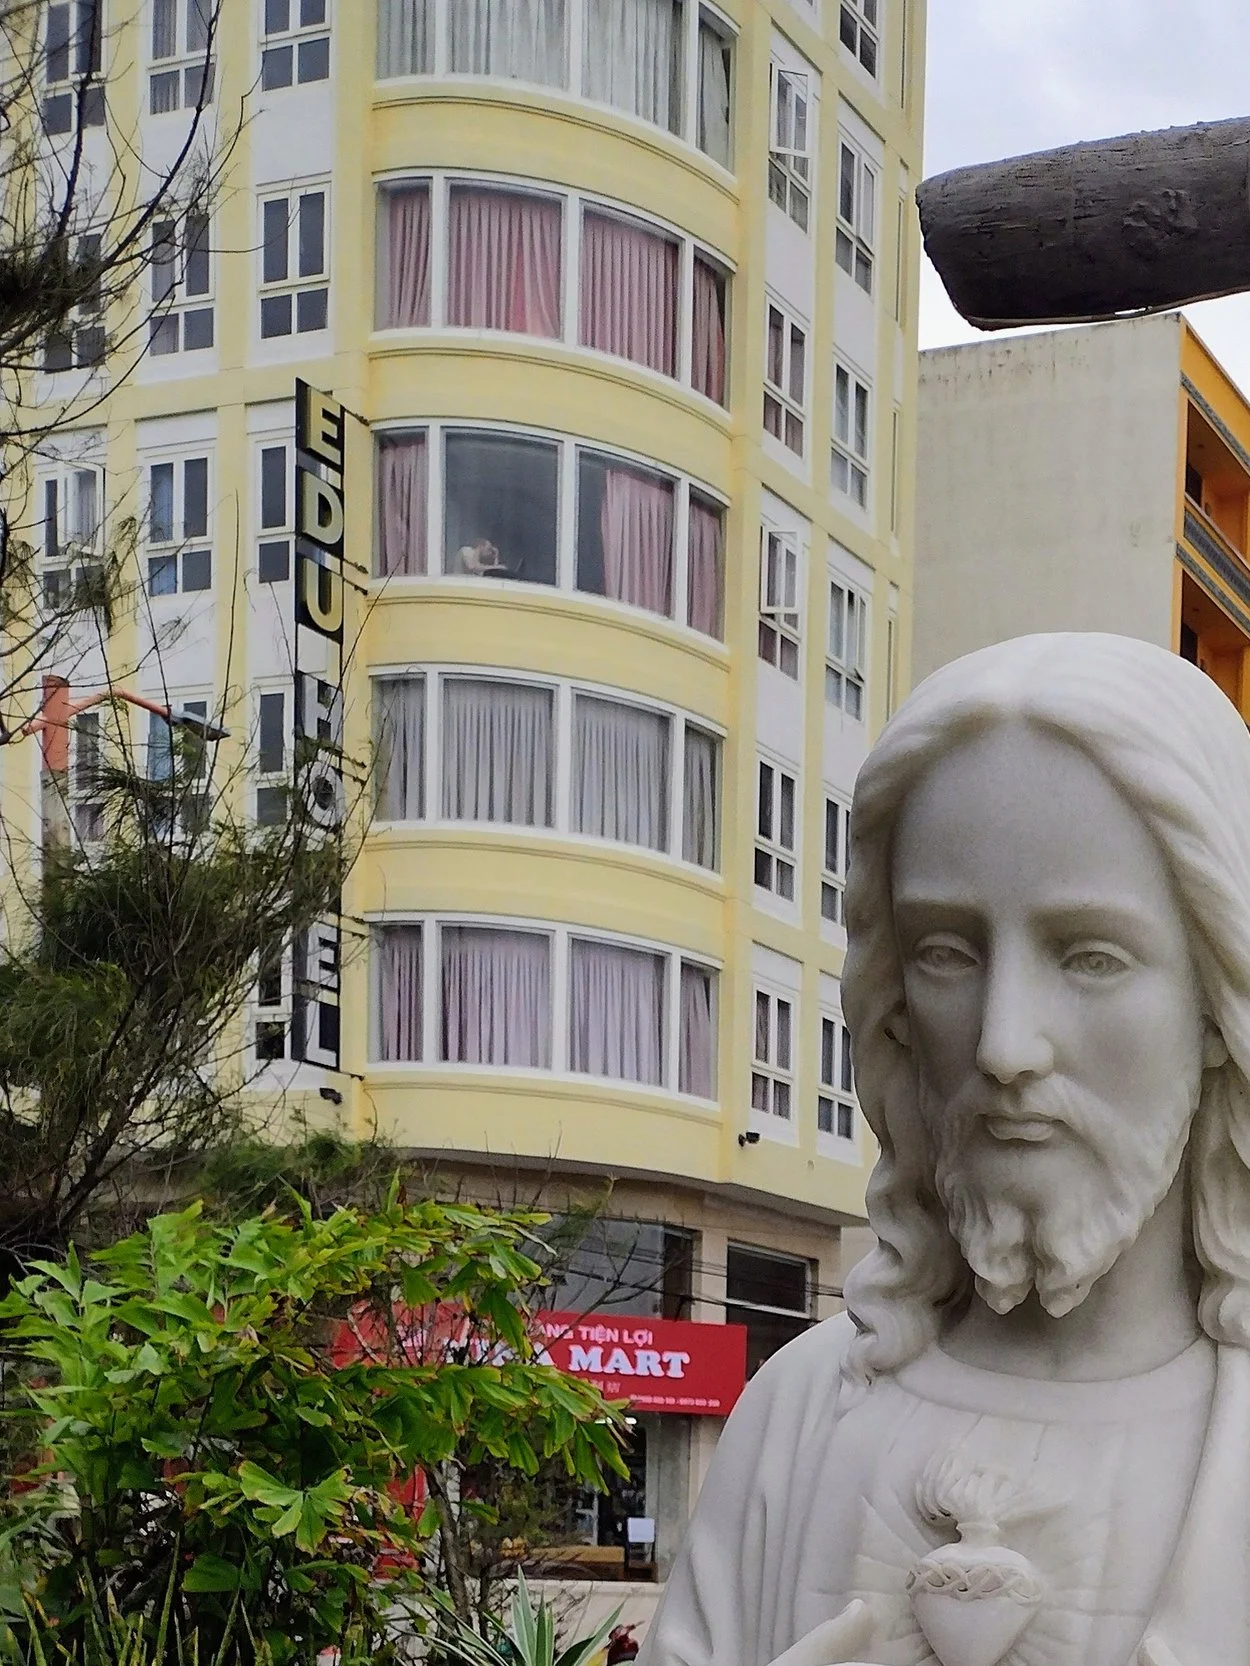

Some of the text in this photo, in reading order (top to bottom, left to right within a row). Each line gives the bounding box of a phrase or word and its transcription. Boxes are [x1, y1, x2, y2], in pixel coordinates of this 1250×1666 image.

[300, 389, 344, 1068] EDU HOEL
[578, 1324, 653, 1347] TIỆN LỢI
[568, 1344, 690, 1378] MART
